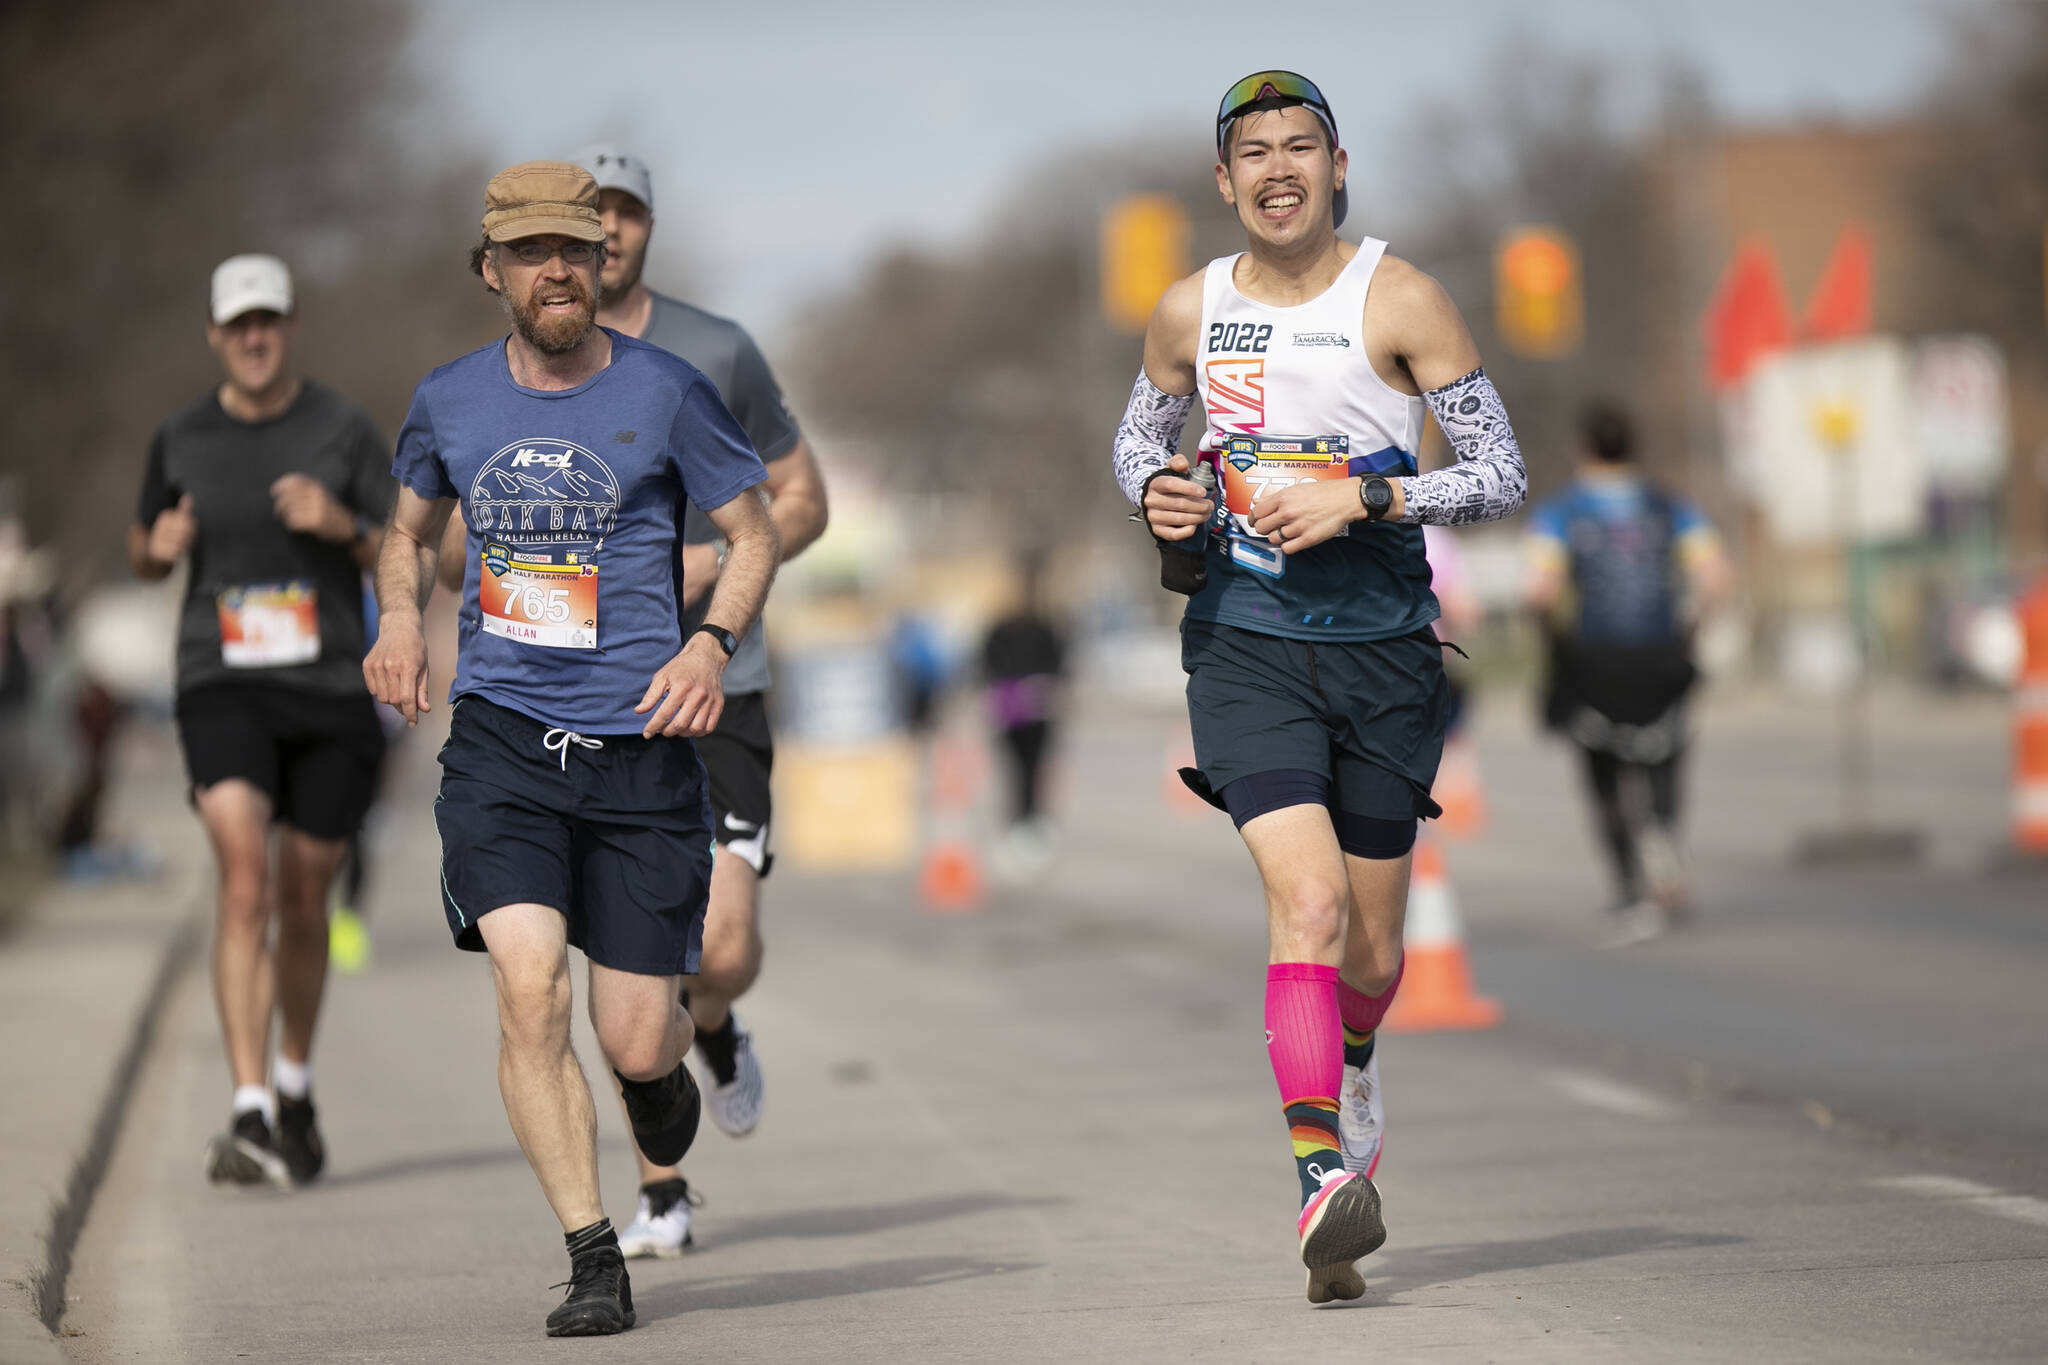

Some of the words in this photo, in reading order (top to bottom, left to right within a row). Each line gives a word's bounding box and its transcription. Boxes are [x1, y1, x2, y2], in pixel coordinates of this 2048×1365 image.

[1208, 323, 1273, 353] 2022
[1292, 335, 1336, 343] TAMARACK
[1233, 442, 1250, 451] WPS
[480, 505, 534, 530] OAK
[550, 505, 609, 530] BAY
[513, 570, 532, 578] HALF
[533, 573, 579, 581] MARATHON
[500, 581, 570, 623] 765
[506, 625, 537, 639] ALLAN
